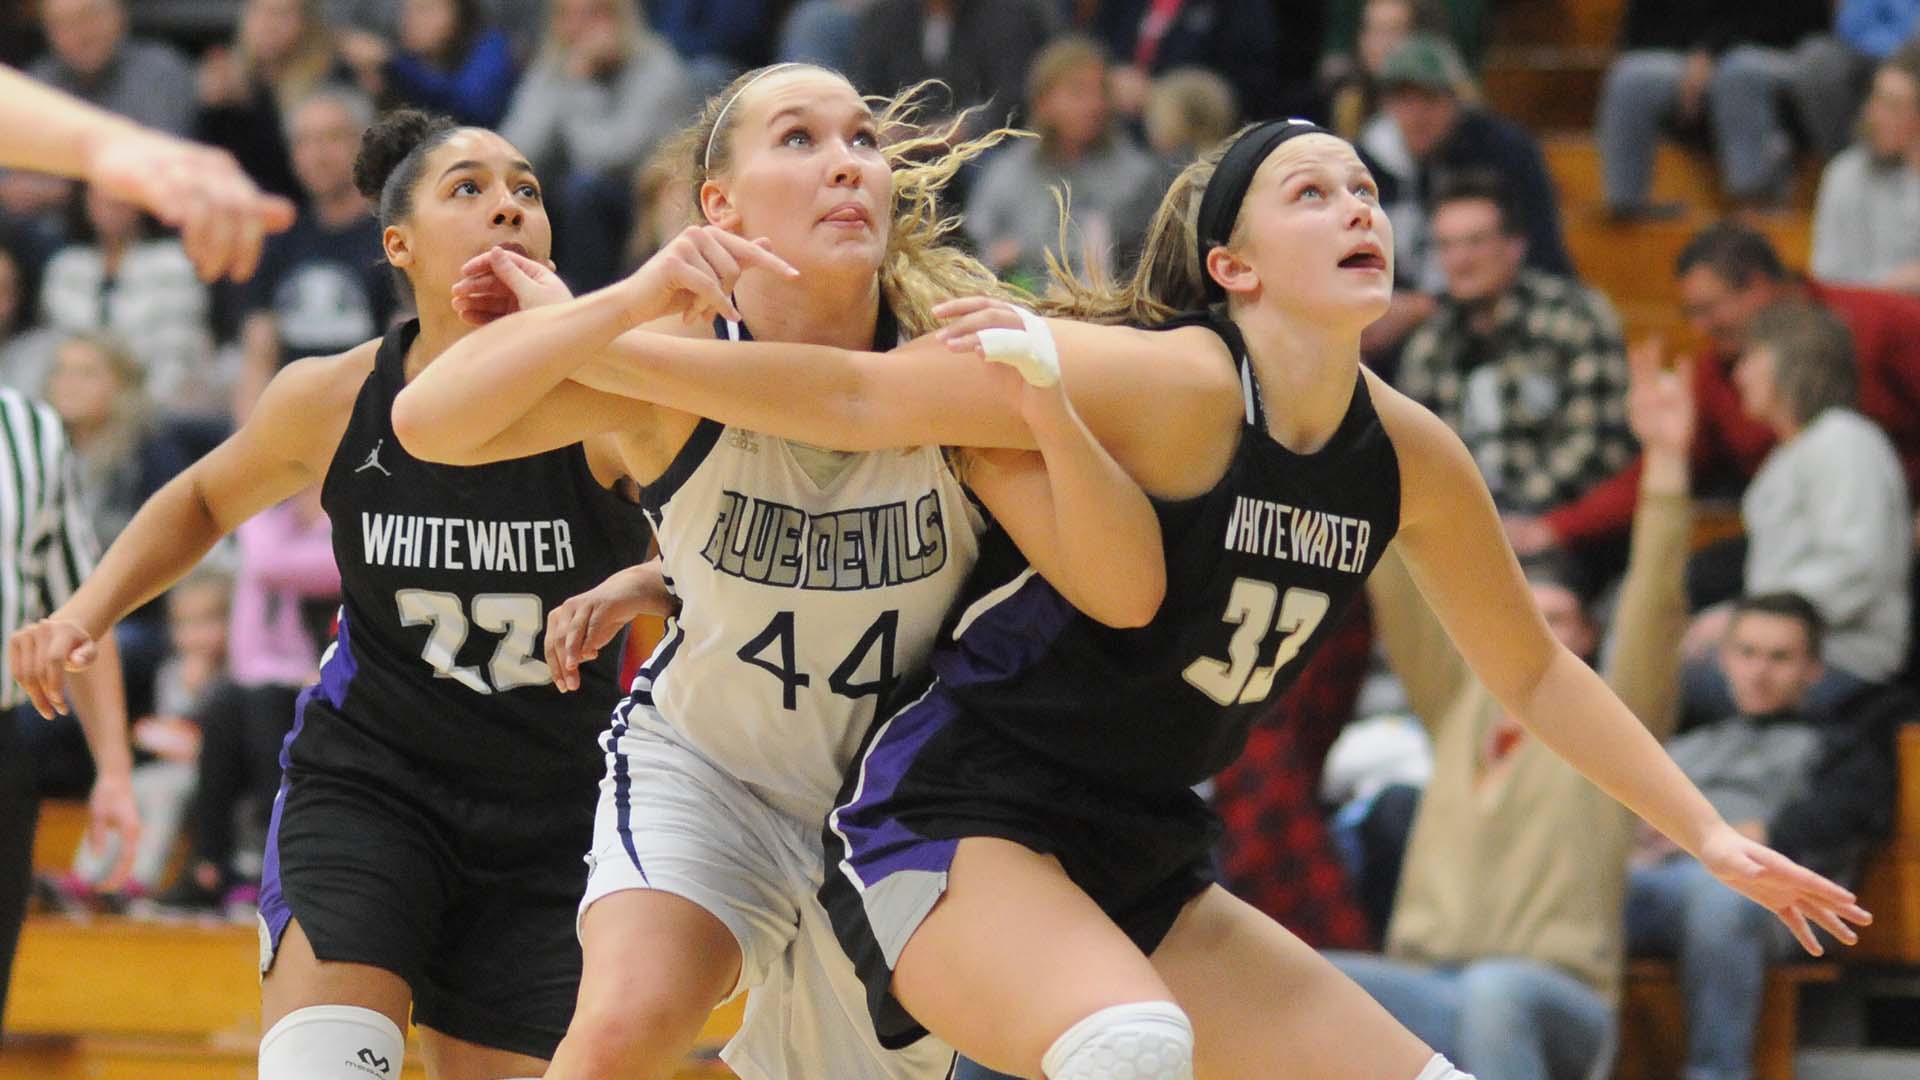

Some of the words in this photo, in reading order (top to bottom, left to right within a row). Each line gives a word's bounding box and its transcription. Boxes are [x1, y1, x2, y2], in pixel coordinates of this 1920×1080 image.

[361, 511, 575, 573] WHITEWATER
[800, 489, 947, 591] DEVILS
[395, 588, 553, 695] 22
[736, 609, 903, 712] 44
